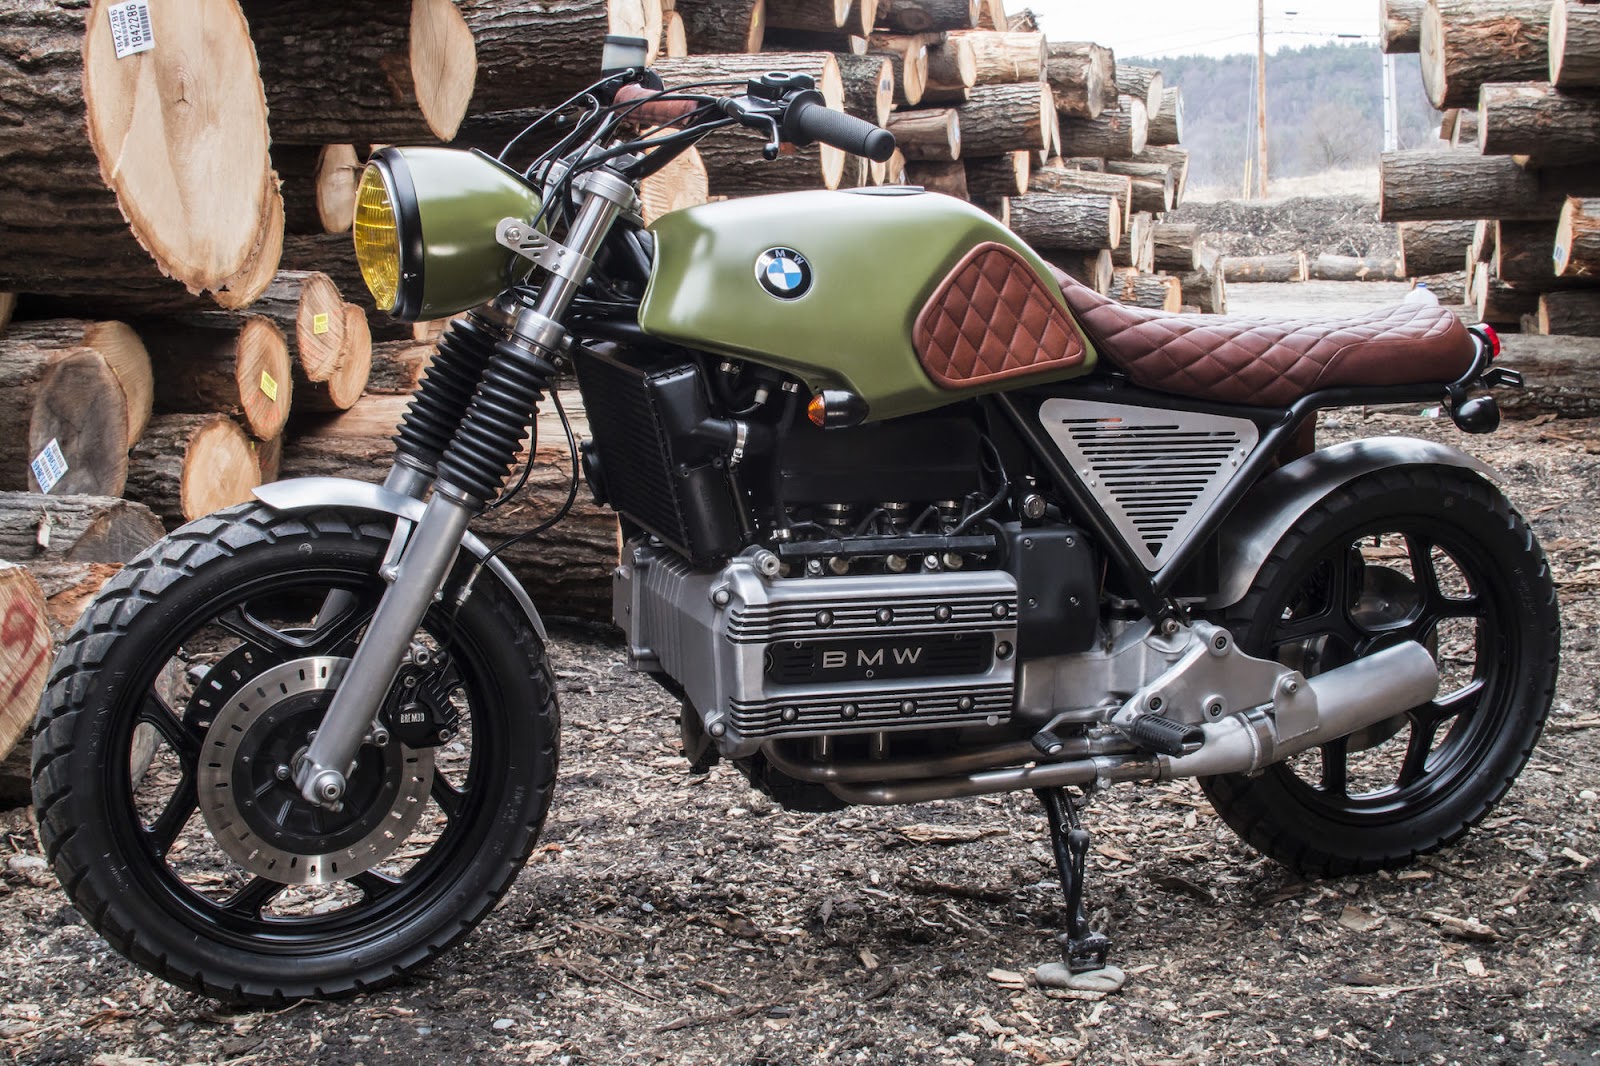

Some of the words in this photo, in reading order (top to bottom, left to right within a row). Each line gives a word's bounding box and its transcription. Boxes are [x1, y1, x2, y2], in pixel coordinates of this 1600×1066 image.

[110, 9, 124, 53] 1842286
[126, 4, 143, 48] 1842286
[760, 249, 805, 266] BMW
[822, 647, 922, 668] BMW
